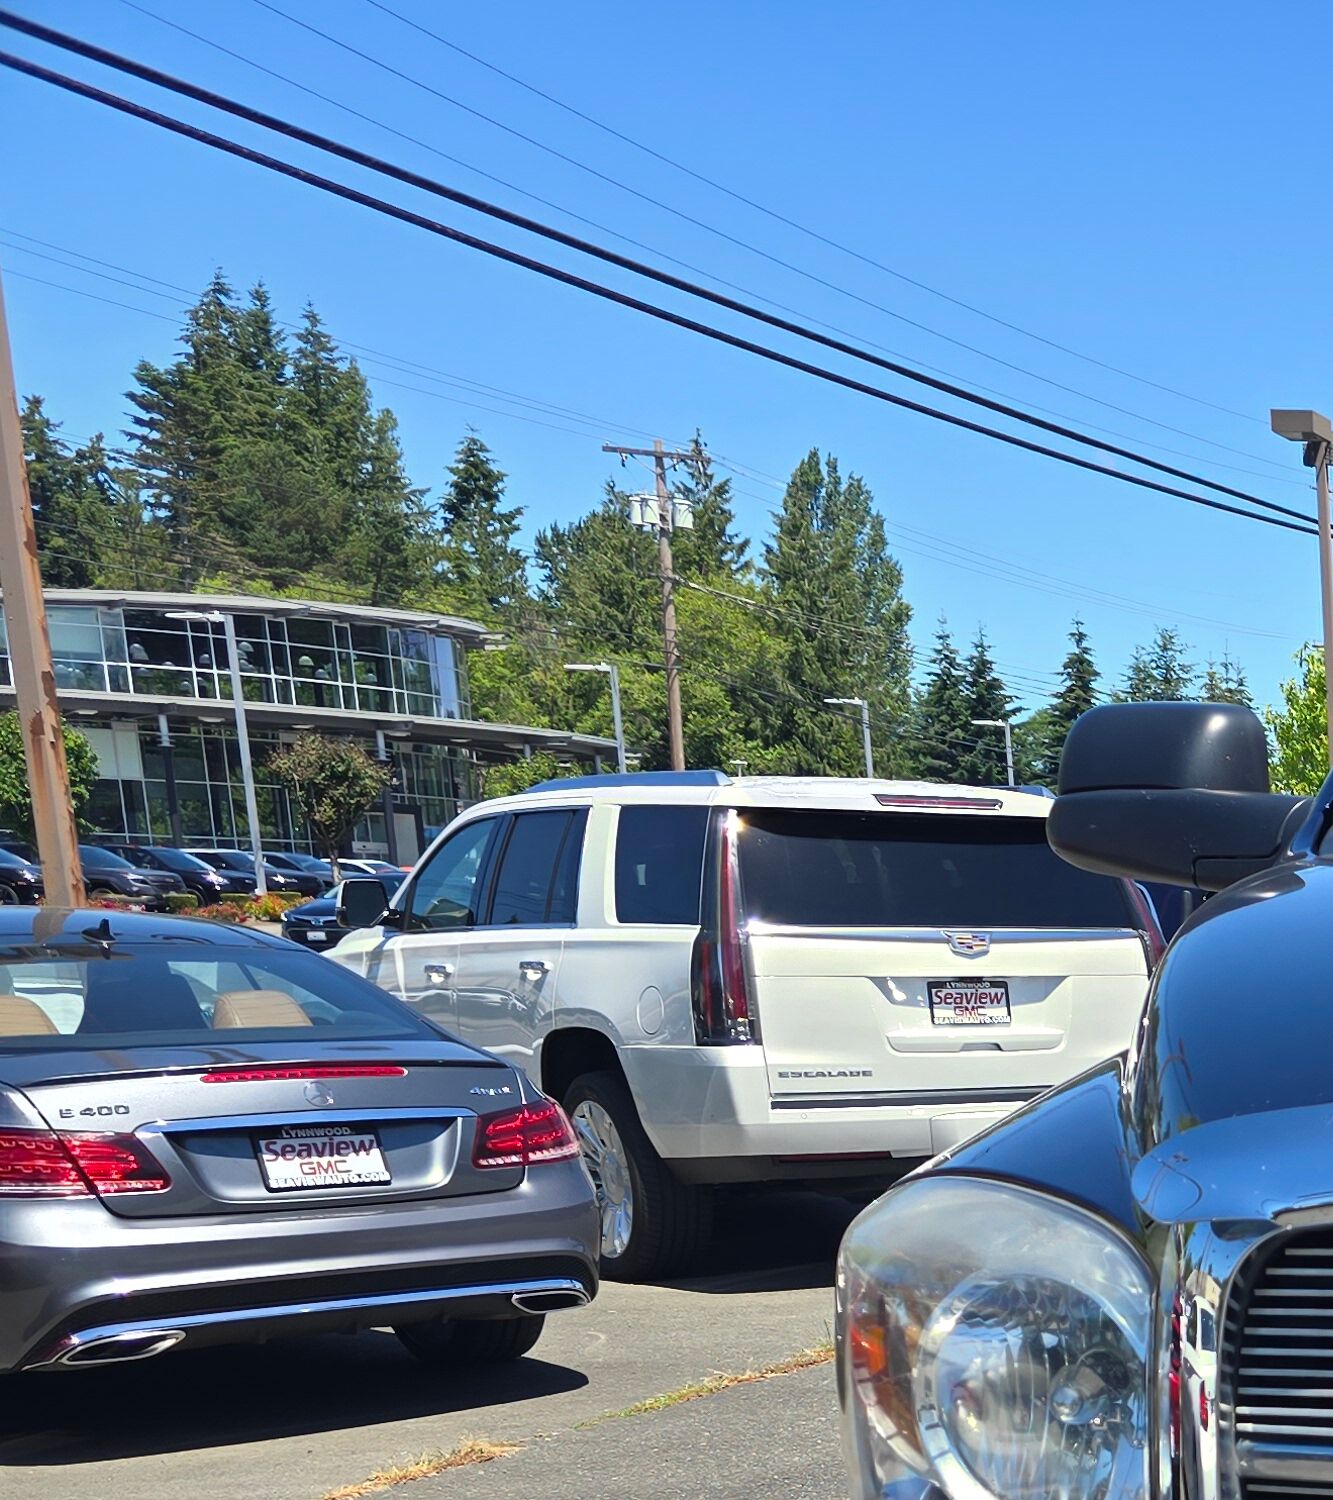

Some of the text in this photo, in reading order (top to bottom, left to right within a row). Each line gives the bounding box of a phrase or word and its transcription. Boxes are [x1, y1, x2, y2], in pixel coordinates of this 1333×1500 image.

[933, 989, 1004, 1006] Seaview
[954, 1005, 988, 1017] GMC
[778, 1070, 873, 1078] ESCALADE
[59, 1104, 130, 1118] E 400
[281, 1126, 352, 1138] LYNNWOOD
[265, 1137, 375, 1162] Seaview
[299, 1160, 352, 1175] GMC
